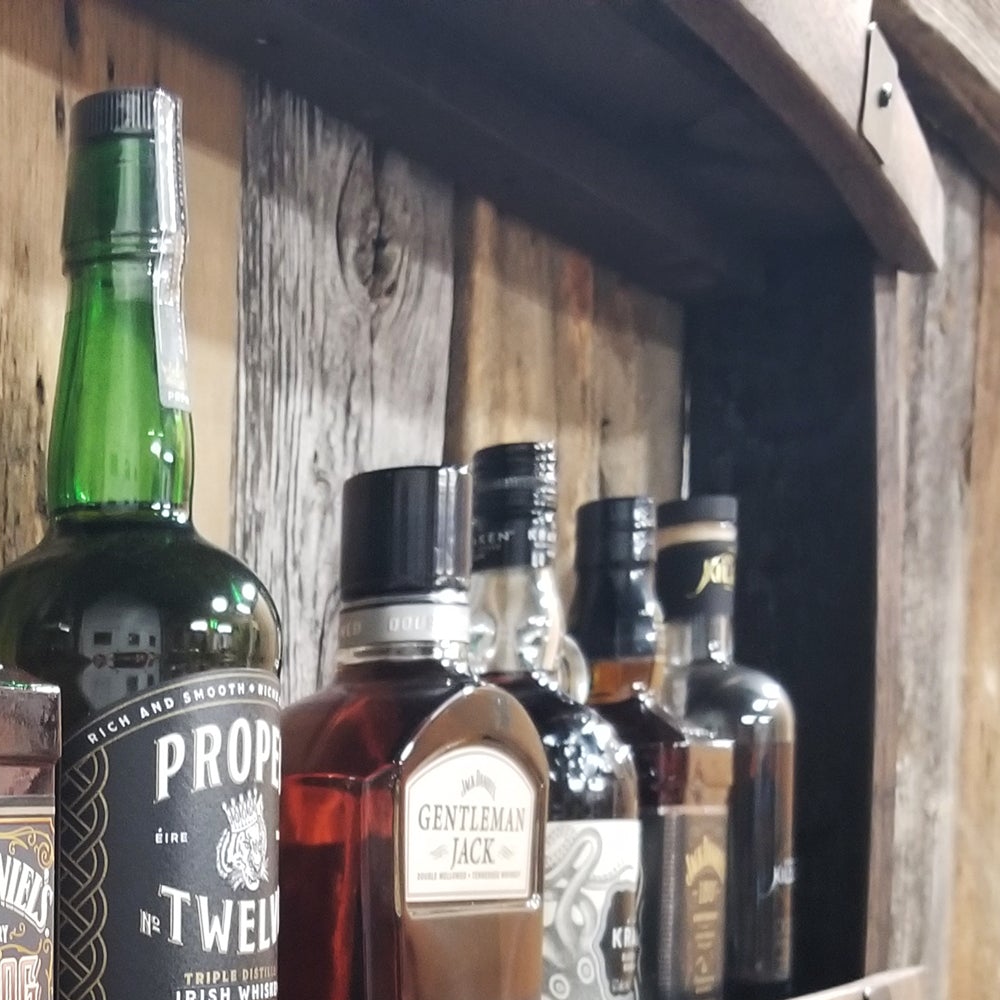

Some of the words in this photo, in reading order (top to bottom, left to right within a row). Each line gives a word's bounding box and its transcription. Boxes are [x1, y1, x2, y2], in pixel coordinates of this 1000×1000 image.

[87, 714, 131, 745] RICH
[139, 697, 175, 720] AND
[183, 683, 245, 704] SMOOTH
[153, 717, 282, 804] PROPE
[418, 803, 526, 832] GENTLEMAN
[450, 837, 496, 870] JACK
[157, 883, 280, 956] TWELV
[183, 968, 237, 986] TRIPLE
